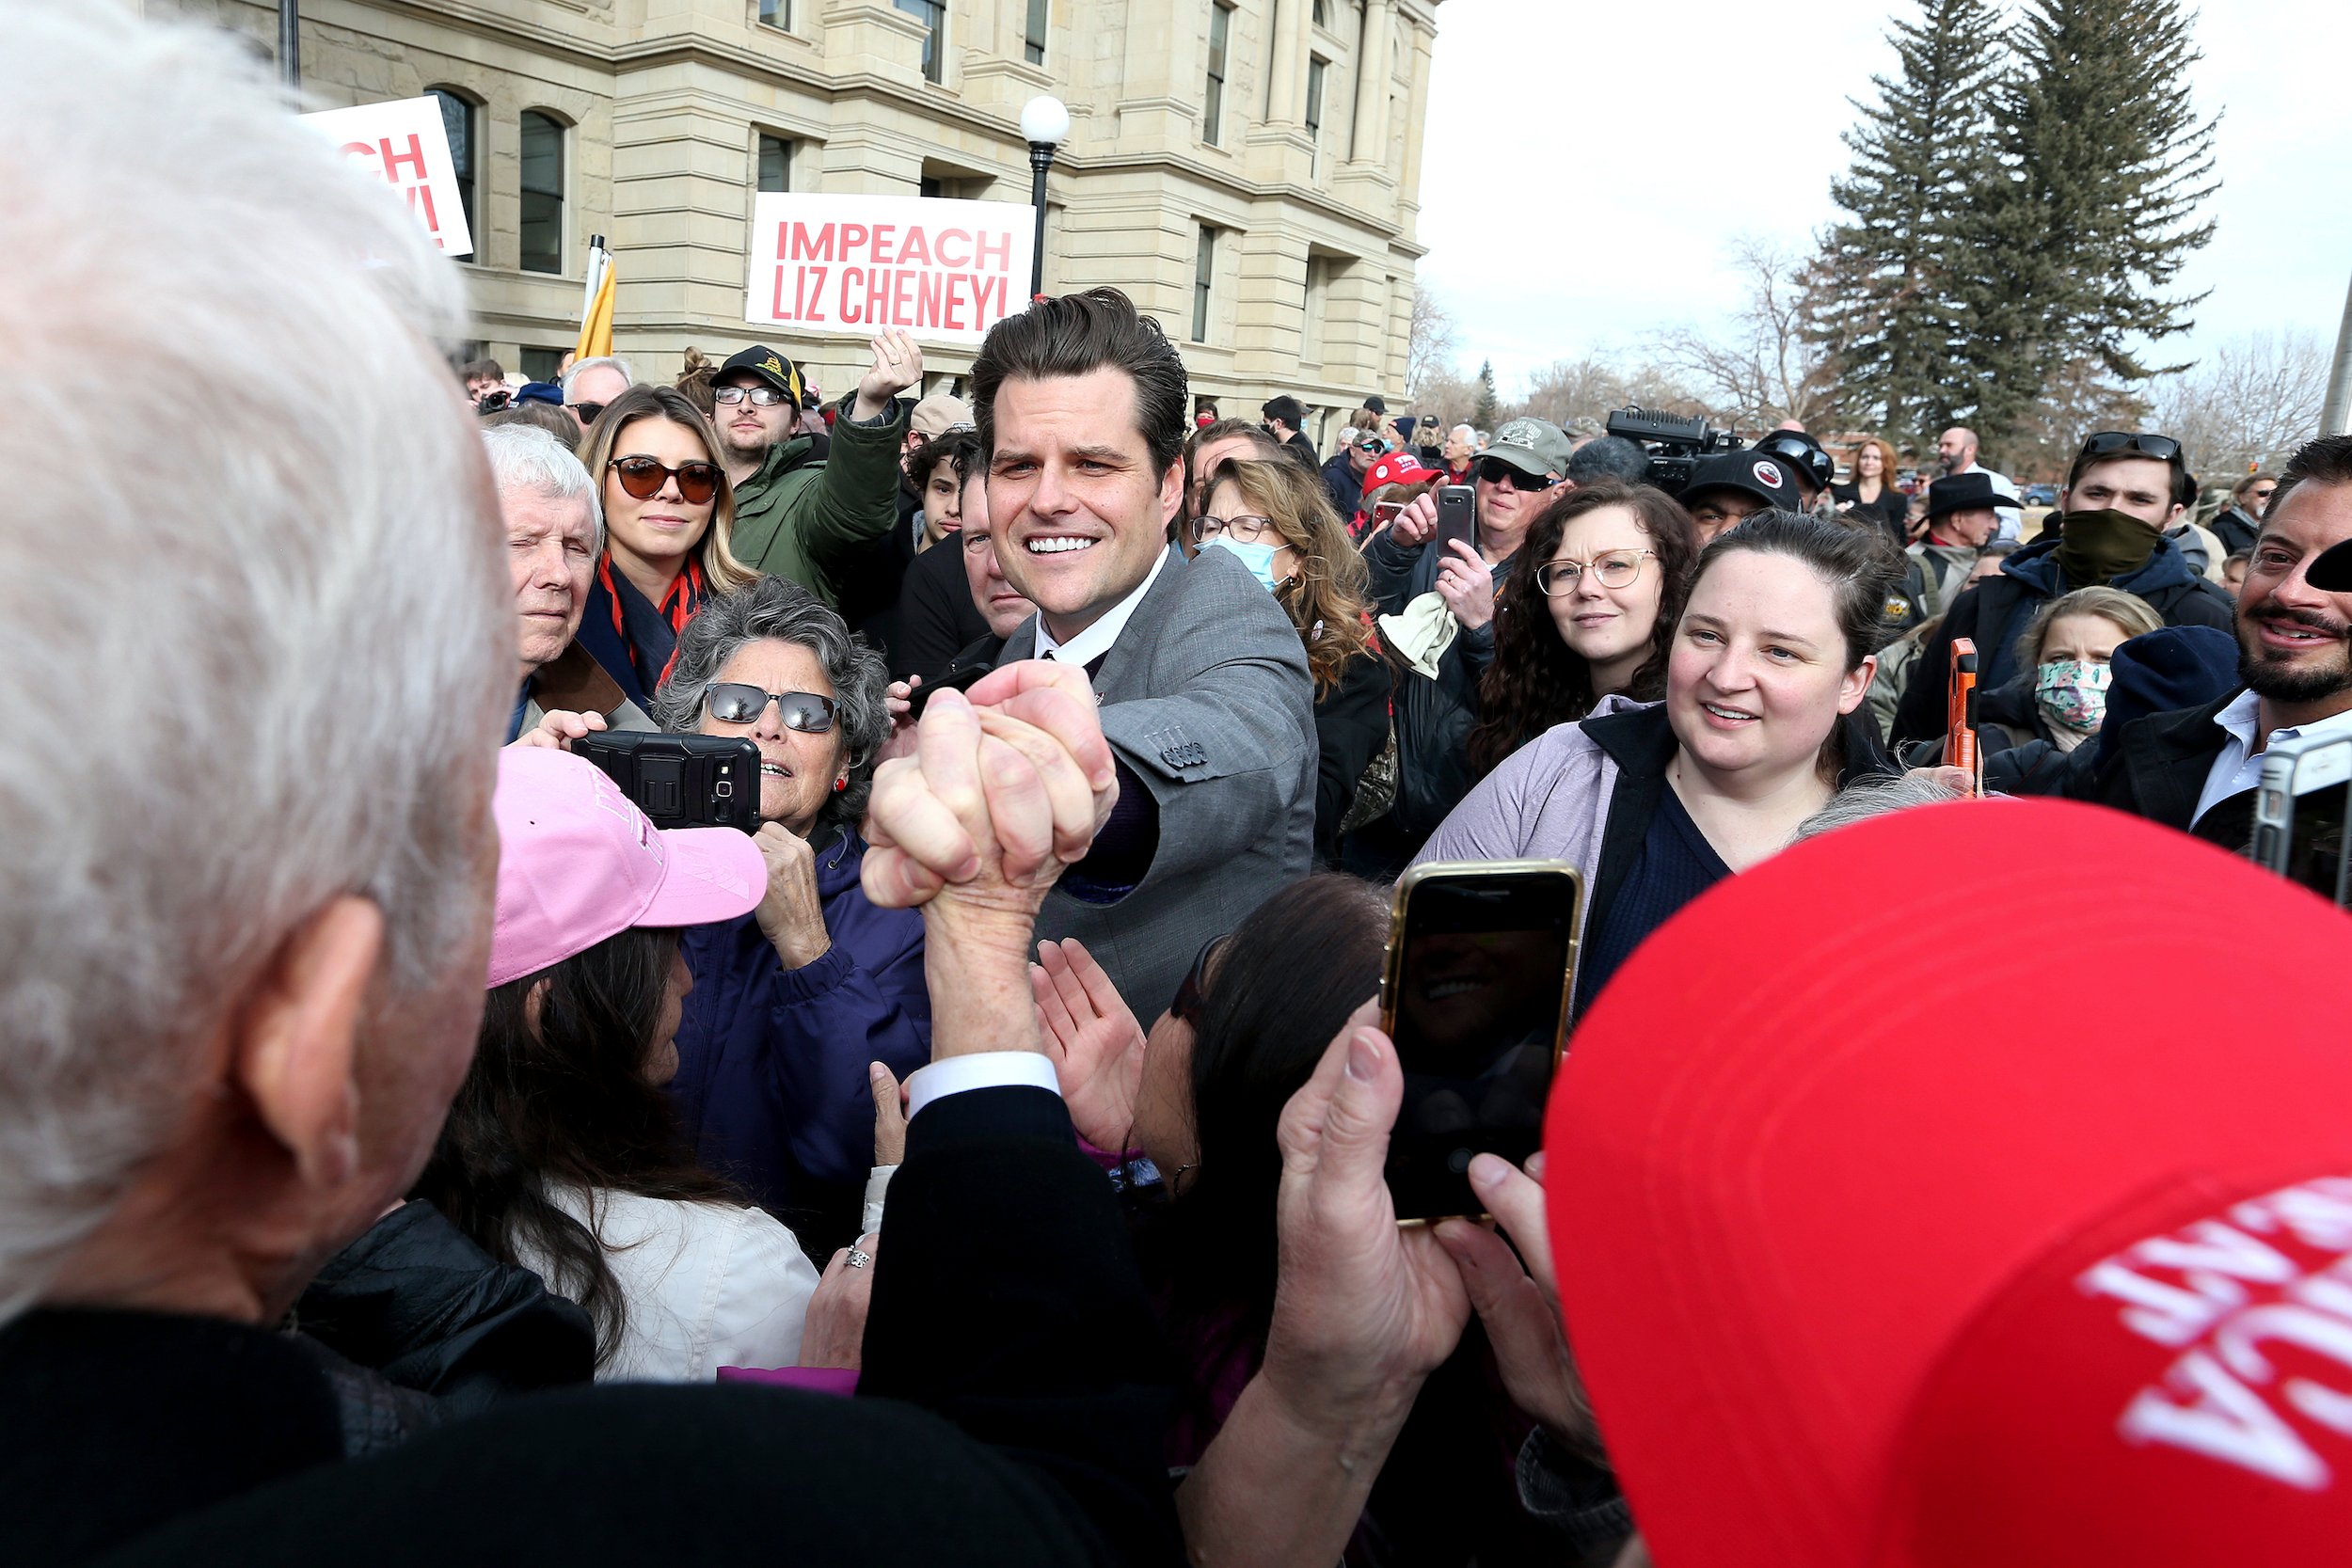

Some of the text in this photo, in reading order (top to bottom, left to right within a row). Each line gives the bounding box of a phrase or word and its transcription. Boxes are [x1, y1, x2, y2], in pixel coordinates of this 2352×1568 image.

[775, 221, 1012, 272] IMPEACH
[771, 264, 1009, 331] LIZ CHENEY!
